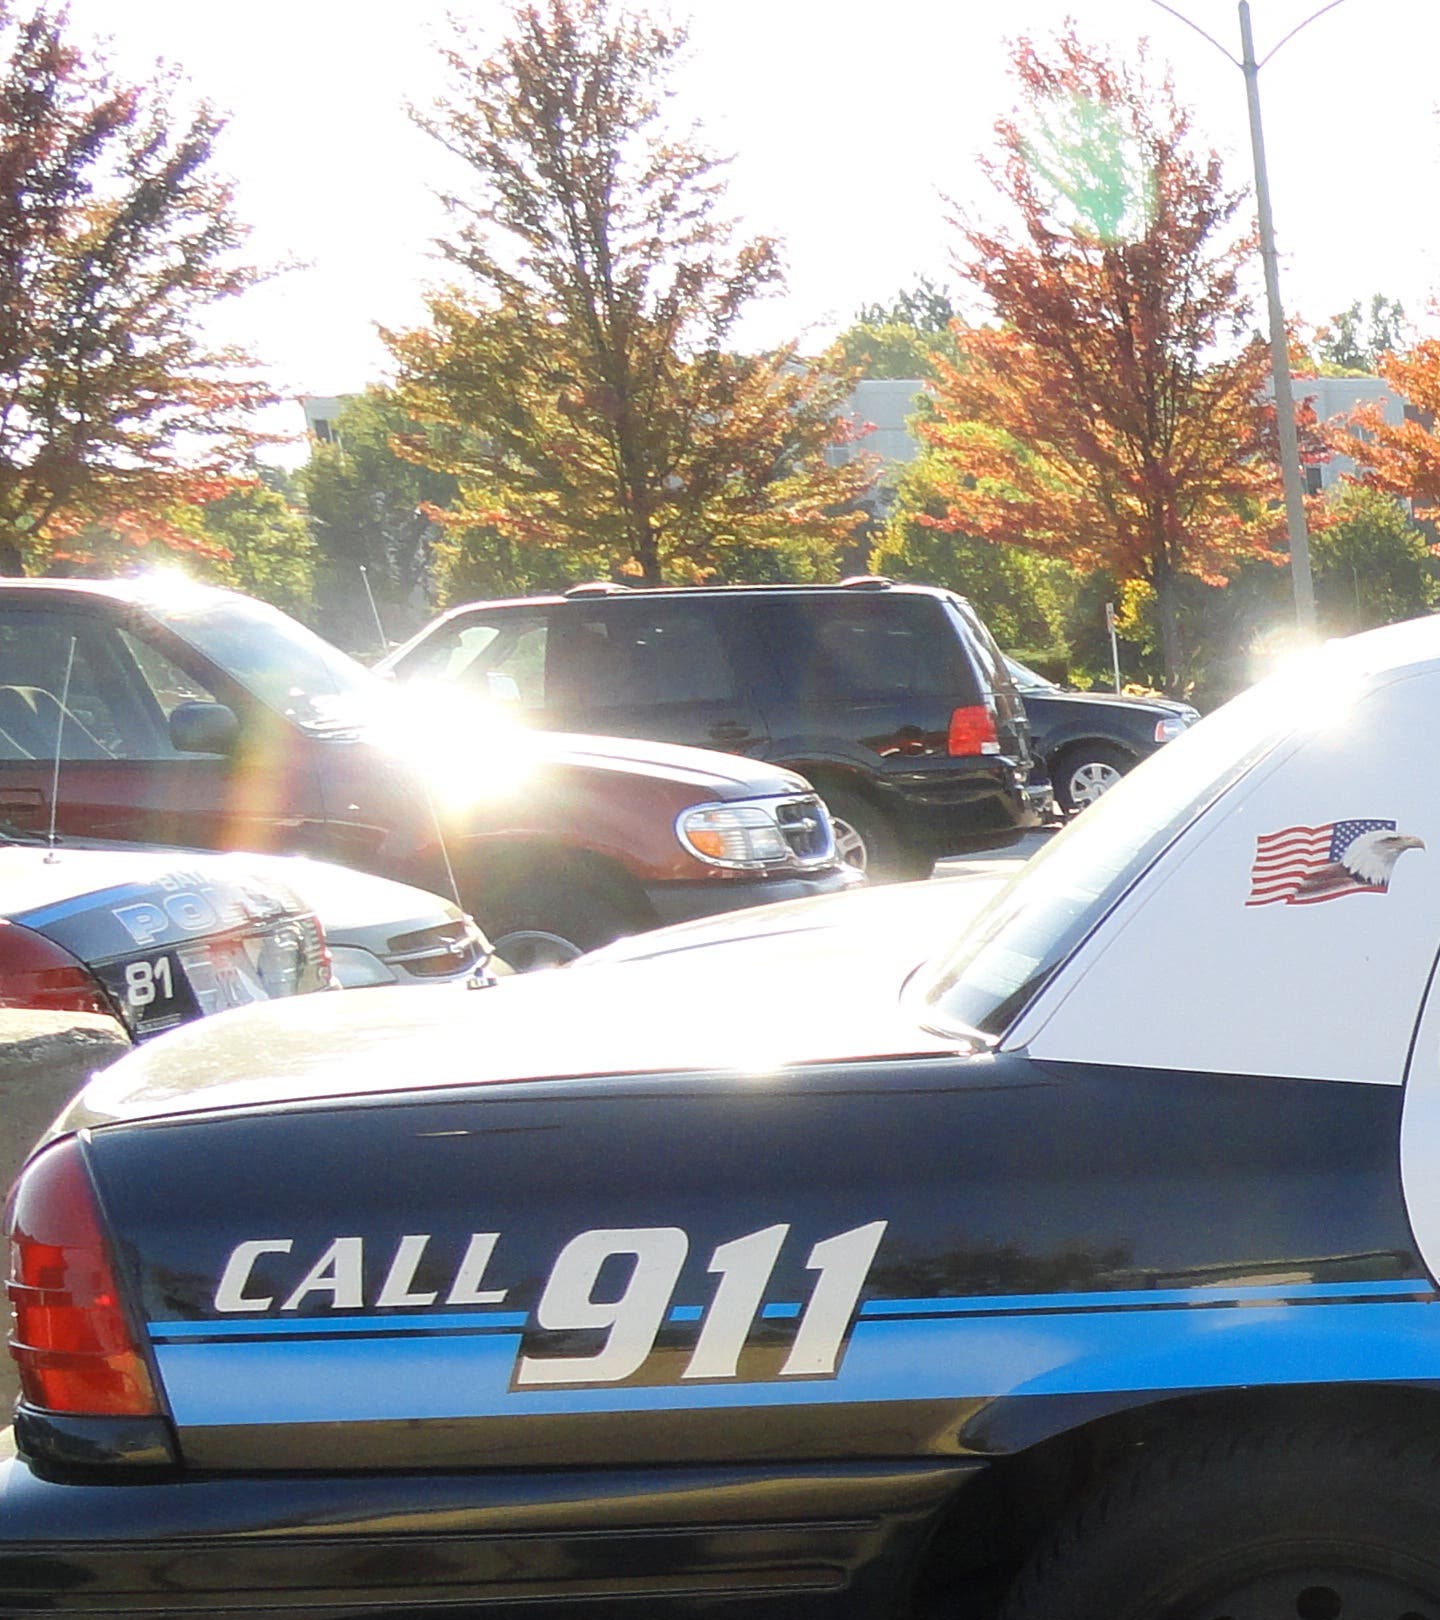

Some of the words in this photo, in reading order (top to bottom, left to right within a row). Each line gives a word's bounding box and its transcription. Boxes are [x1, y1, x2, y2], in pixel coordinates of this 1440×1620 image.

[125, 956, 174, 1006] 81
[214, 1232, 508, 1312] CALL
[512, 1219, 889, 1391] 911
